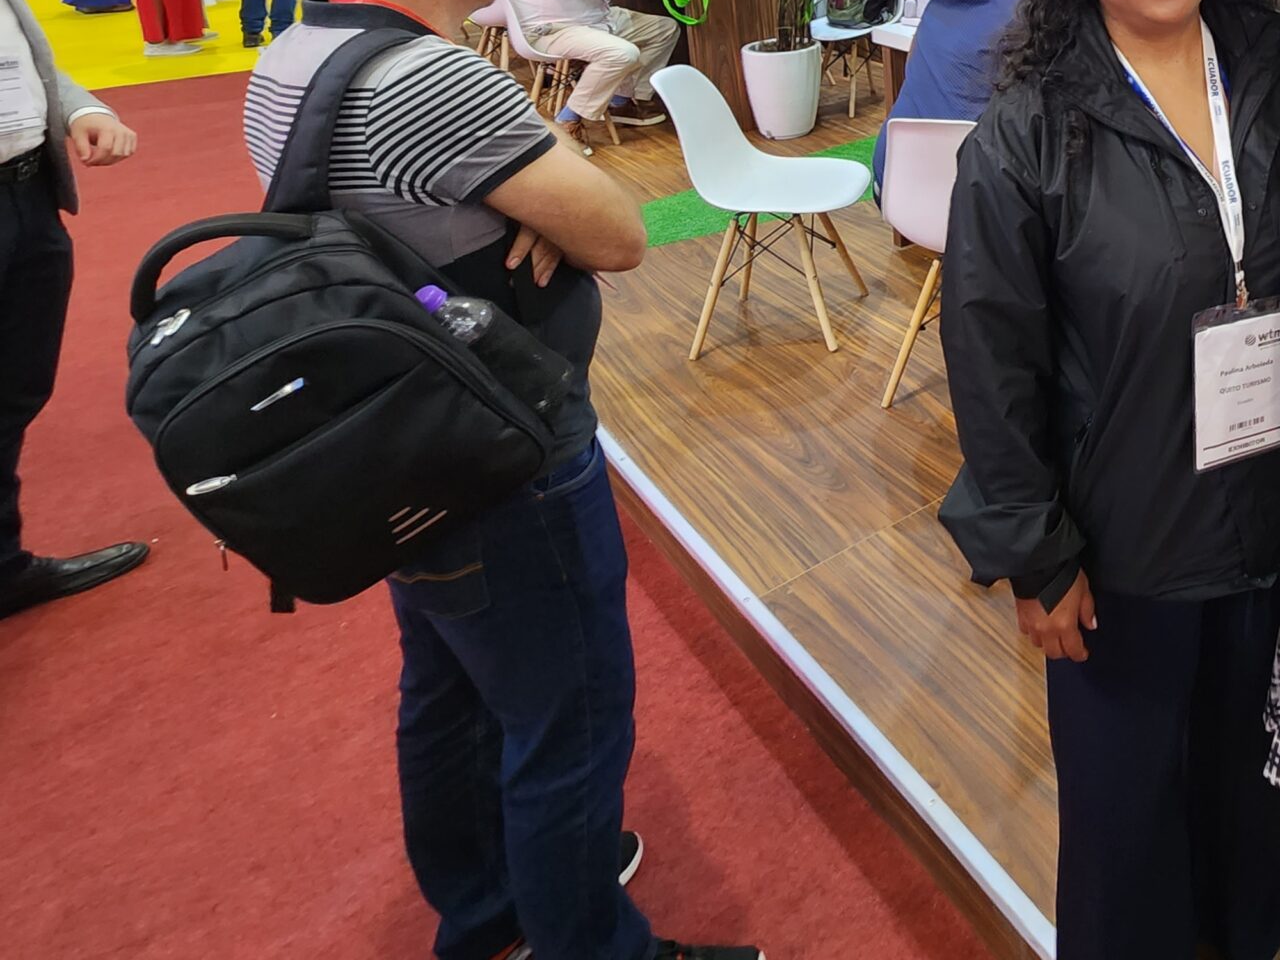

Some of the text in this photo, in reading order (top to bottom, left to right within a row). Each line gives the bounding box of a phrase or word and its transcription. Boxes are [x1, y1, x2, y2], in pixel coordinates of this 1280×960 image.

[1207, 57, 1219, 97] ECUADOR
[1221, 160, 1237, 204] ECUADOR
[1219, 384, 1241, 395] QUITO
